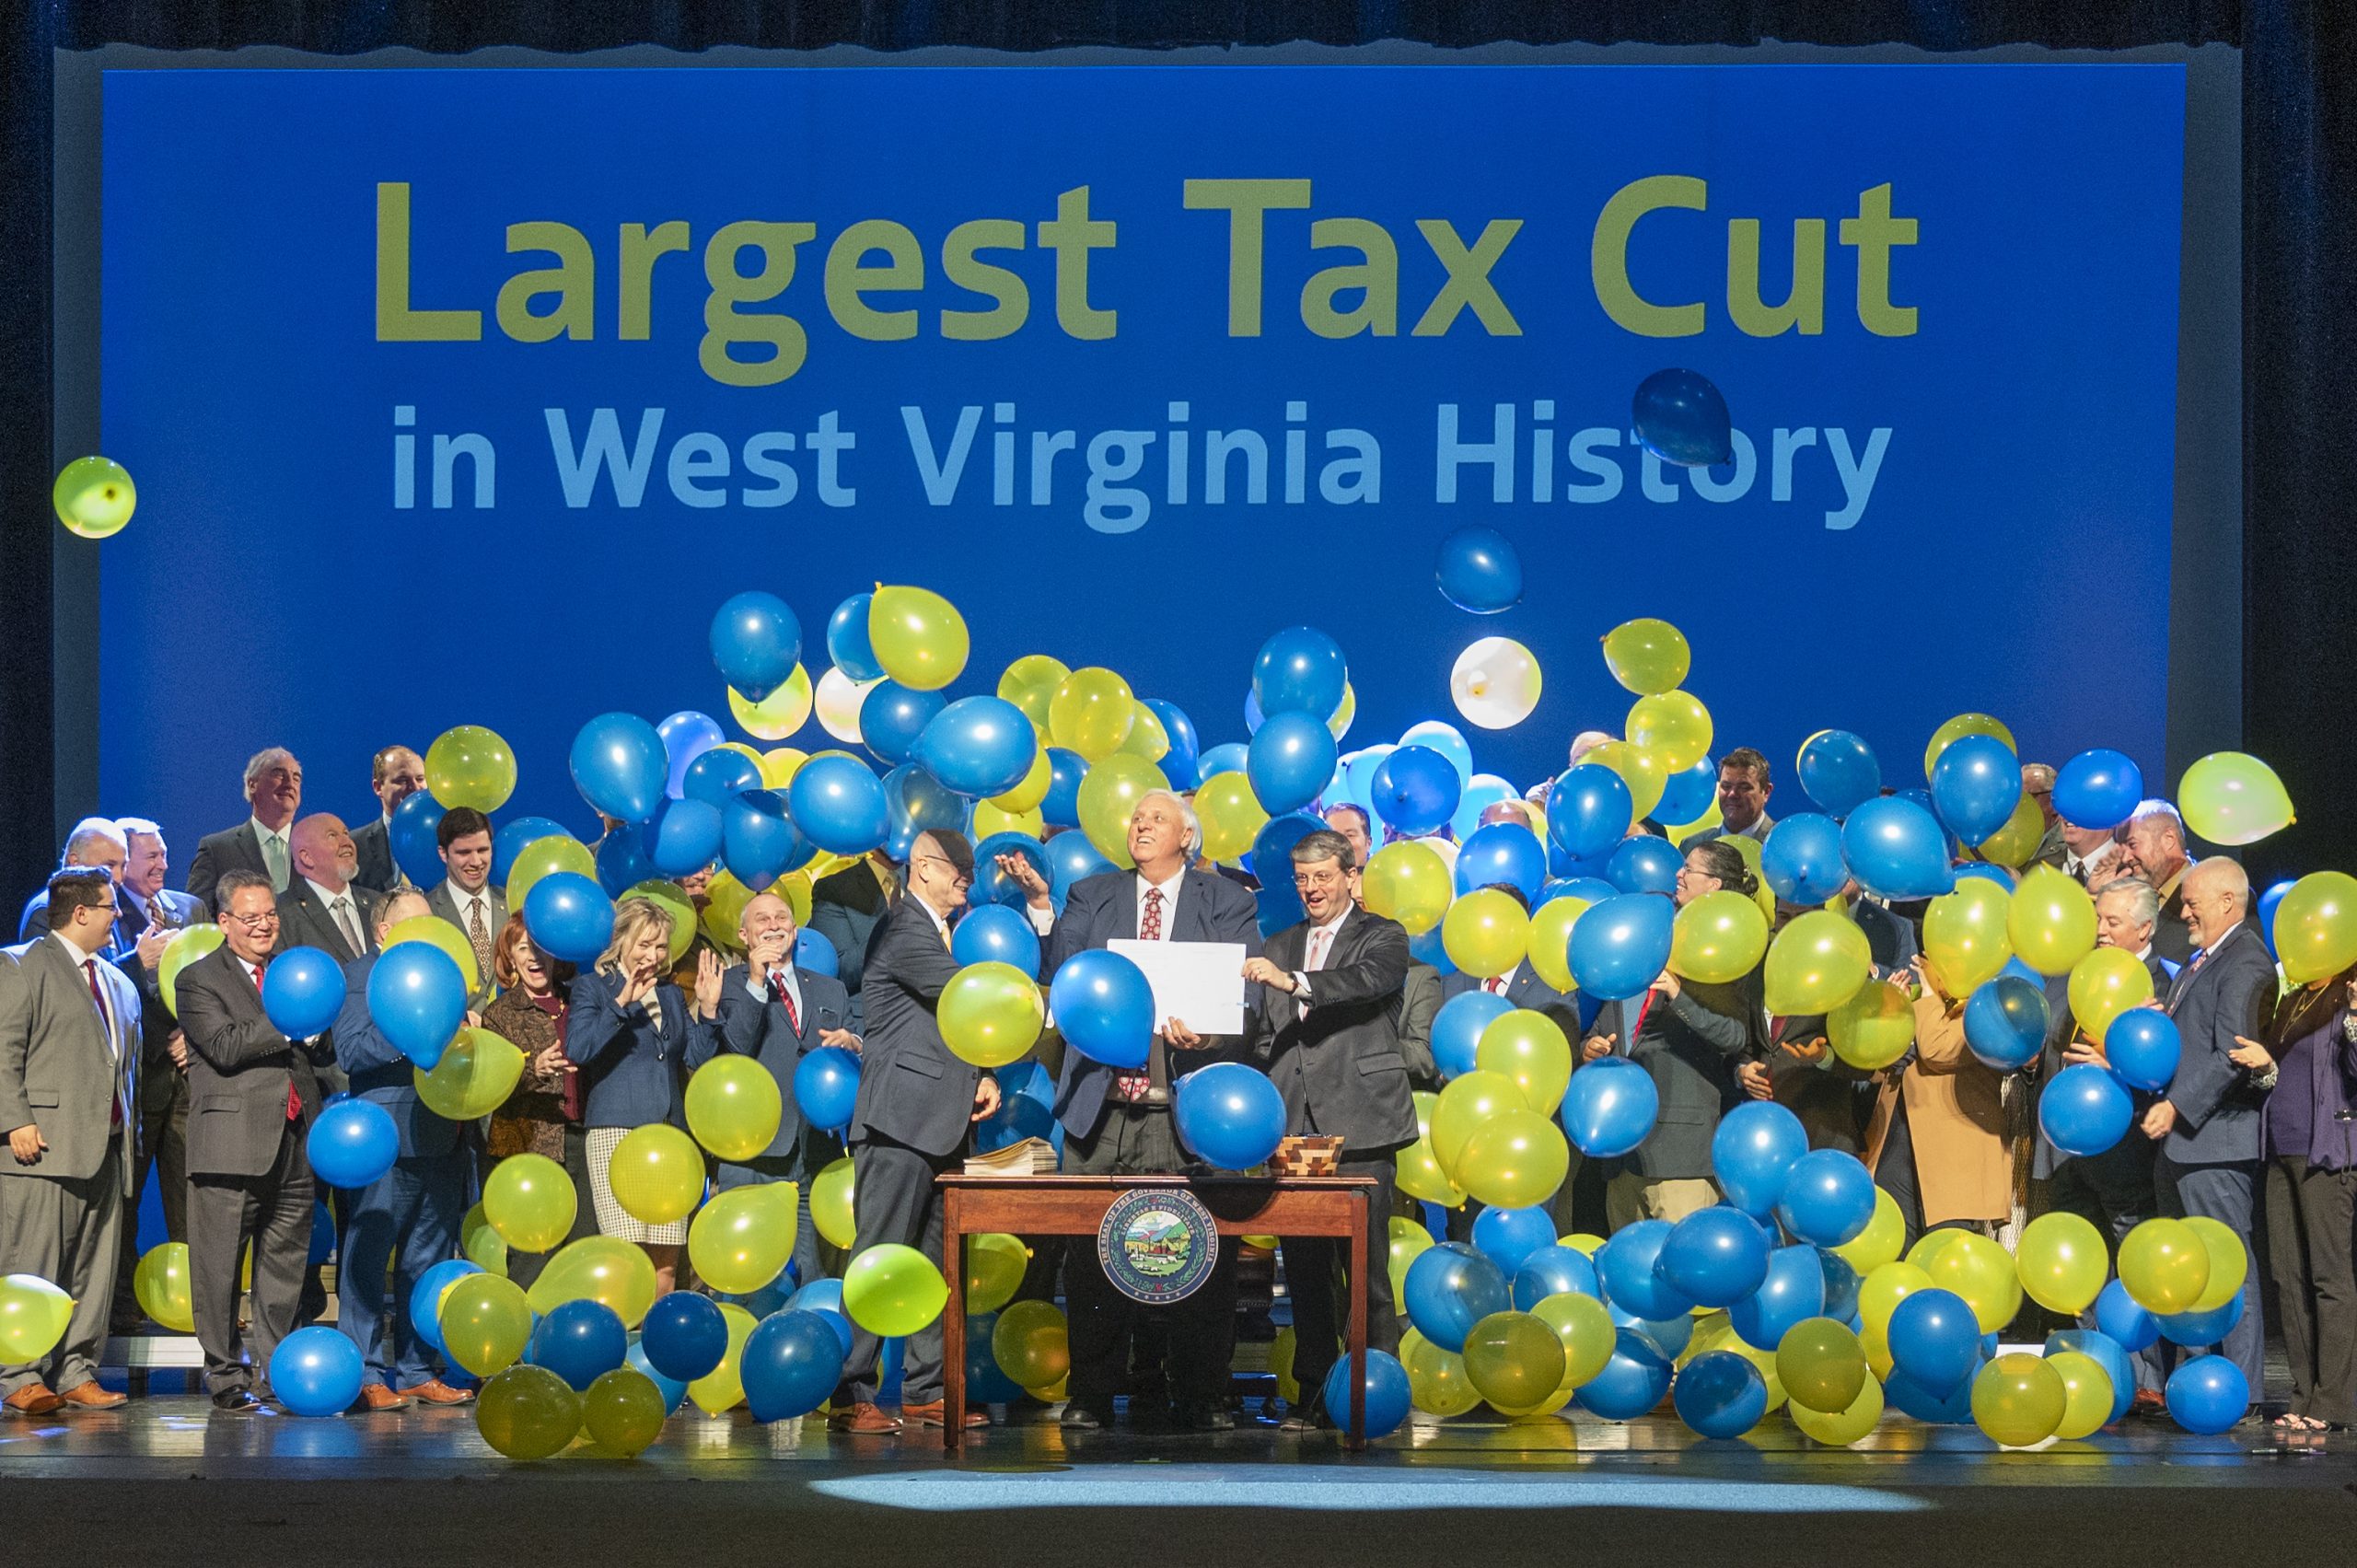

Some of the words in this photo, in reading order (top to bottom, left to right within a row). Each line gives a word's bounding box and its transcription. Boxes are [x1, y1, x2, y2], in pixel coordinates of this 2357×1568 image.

[377, 183, 1116, 386] Largest
[1184, 179, 1523, 341] Tax
[1592, 176, 1917, 337] Cut
[395, 405, 494, 508] in
[545, 409, 855, 508] West
[900, 401, 1380, 533] Virginia
[1114, 1195, 1132, 1210] THE
[1179, 1191, 1192, 1201] OF
[1107, 1209, 1117, 1221] OF
[1192, 1200, 1209, 1220] WEST
[1101, 1223, 1109, 1244] SEAL
[1207, 1221, 1215, 1262] VIRGINIA
[1101, 1247, 1109, 1264] THE
